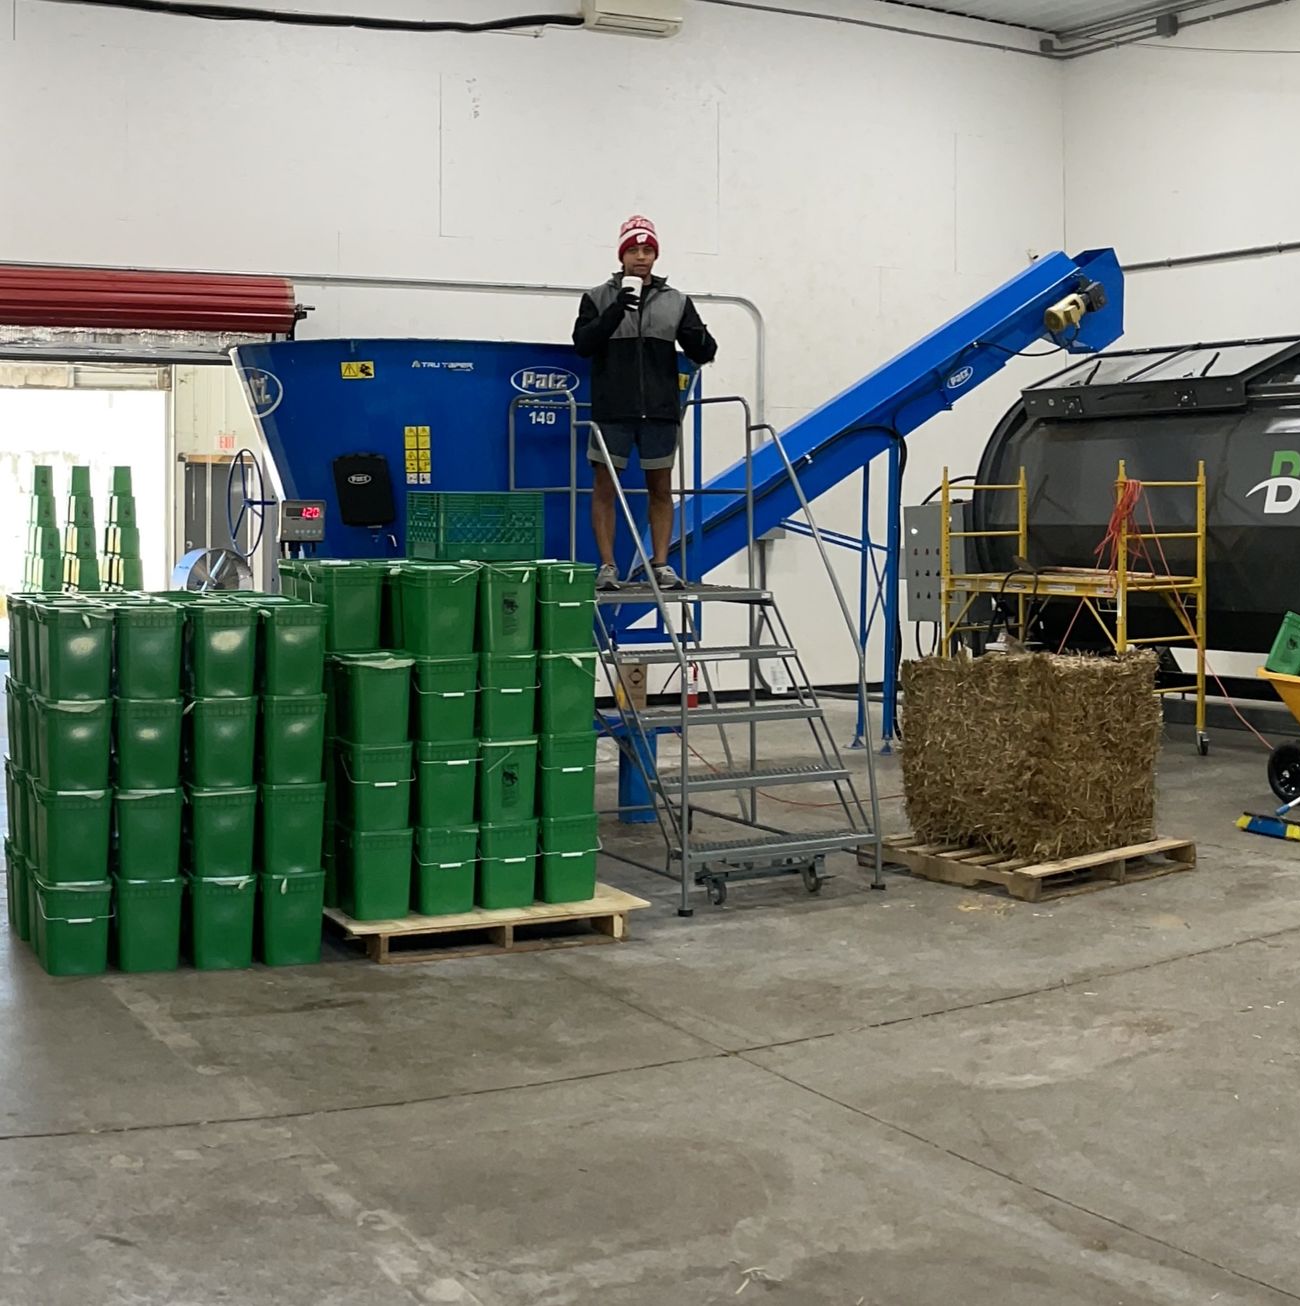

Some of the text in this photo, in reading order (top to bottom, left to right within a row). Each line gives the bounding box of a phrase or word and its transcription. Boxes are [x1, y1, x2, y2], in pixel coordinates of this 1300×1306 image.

[521, 371, 569, 389] Patz
[950, 367, 970, 386] Patz
[528, 411, 556, 425] 140
[302, 506, 320, 518] 120
